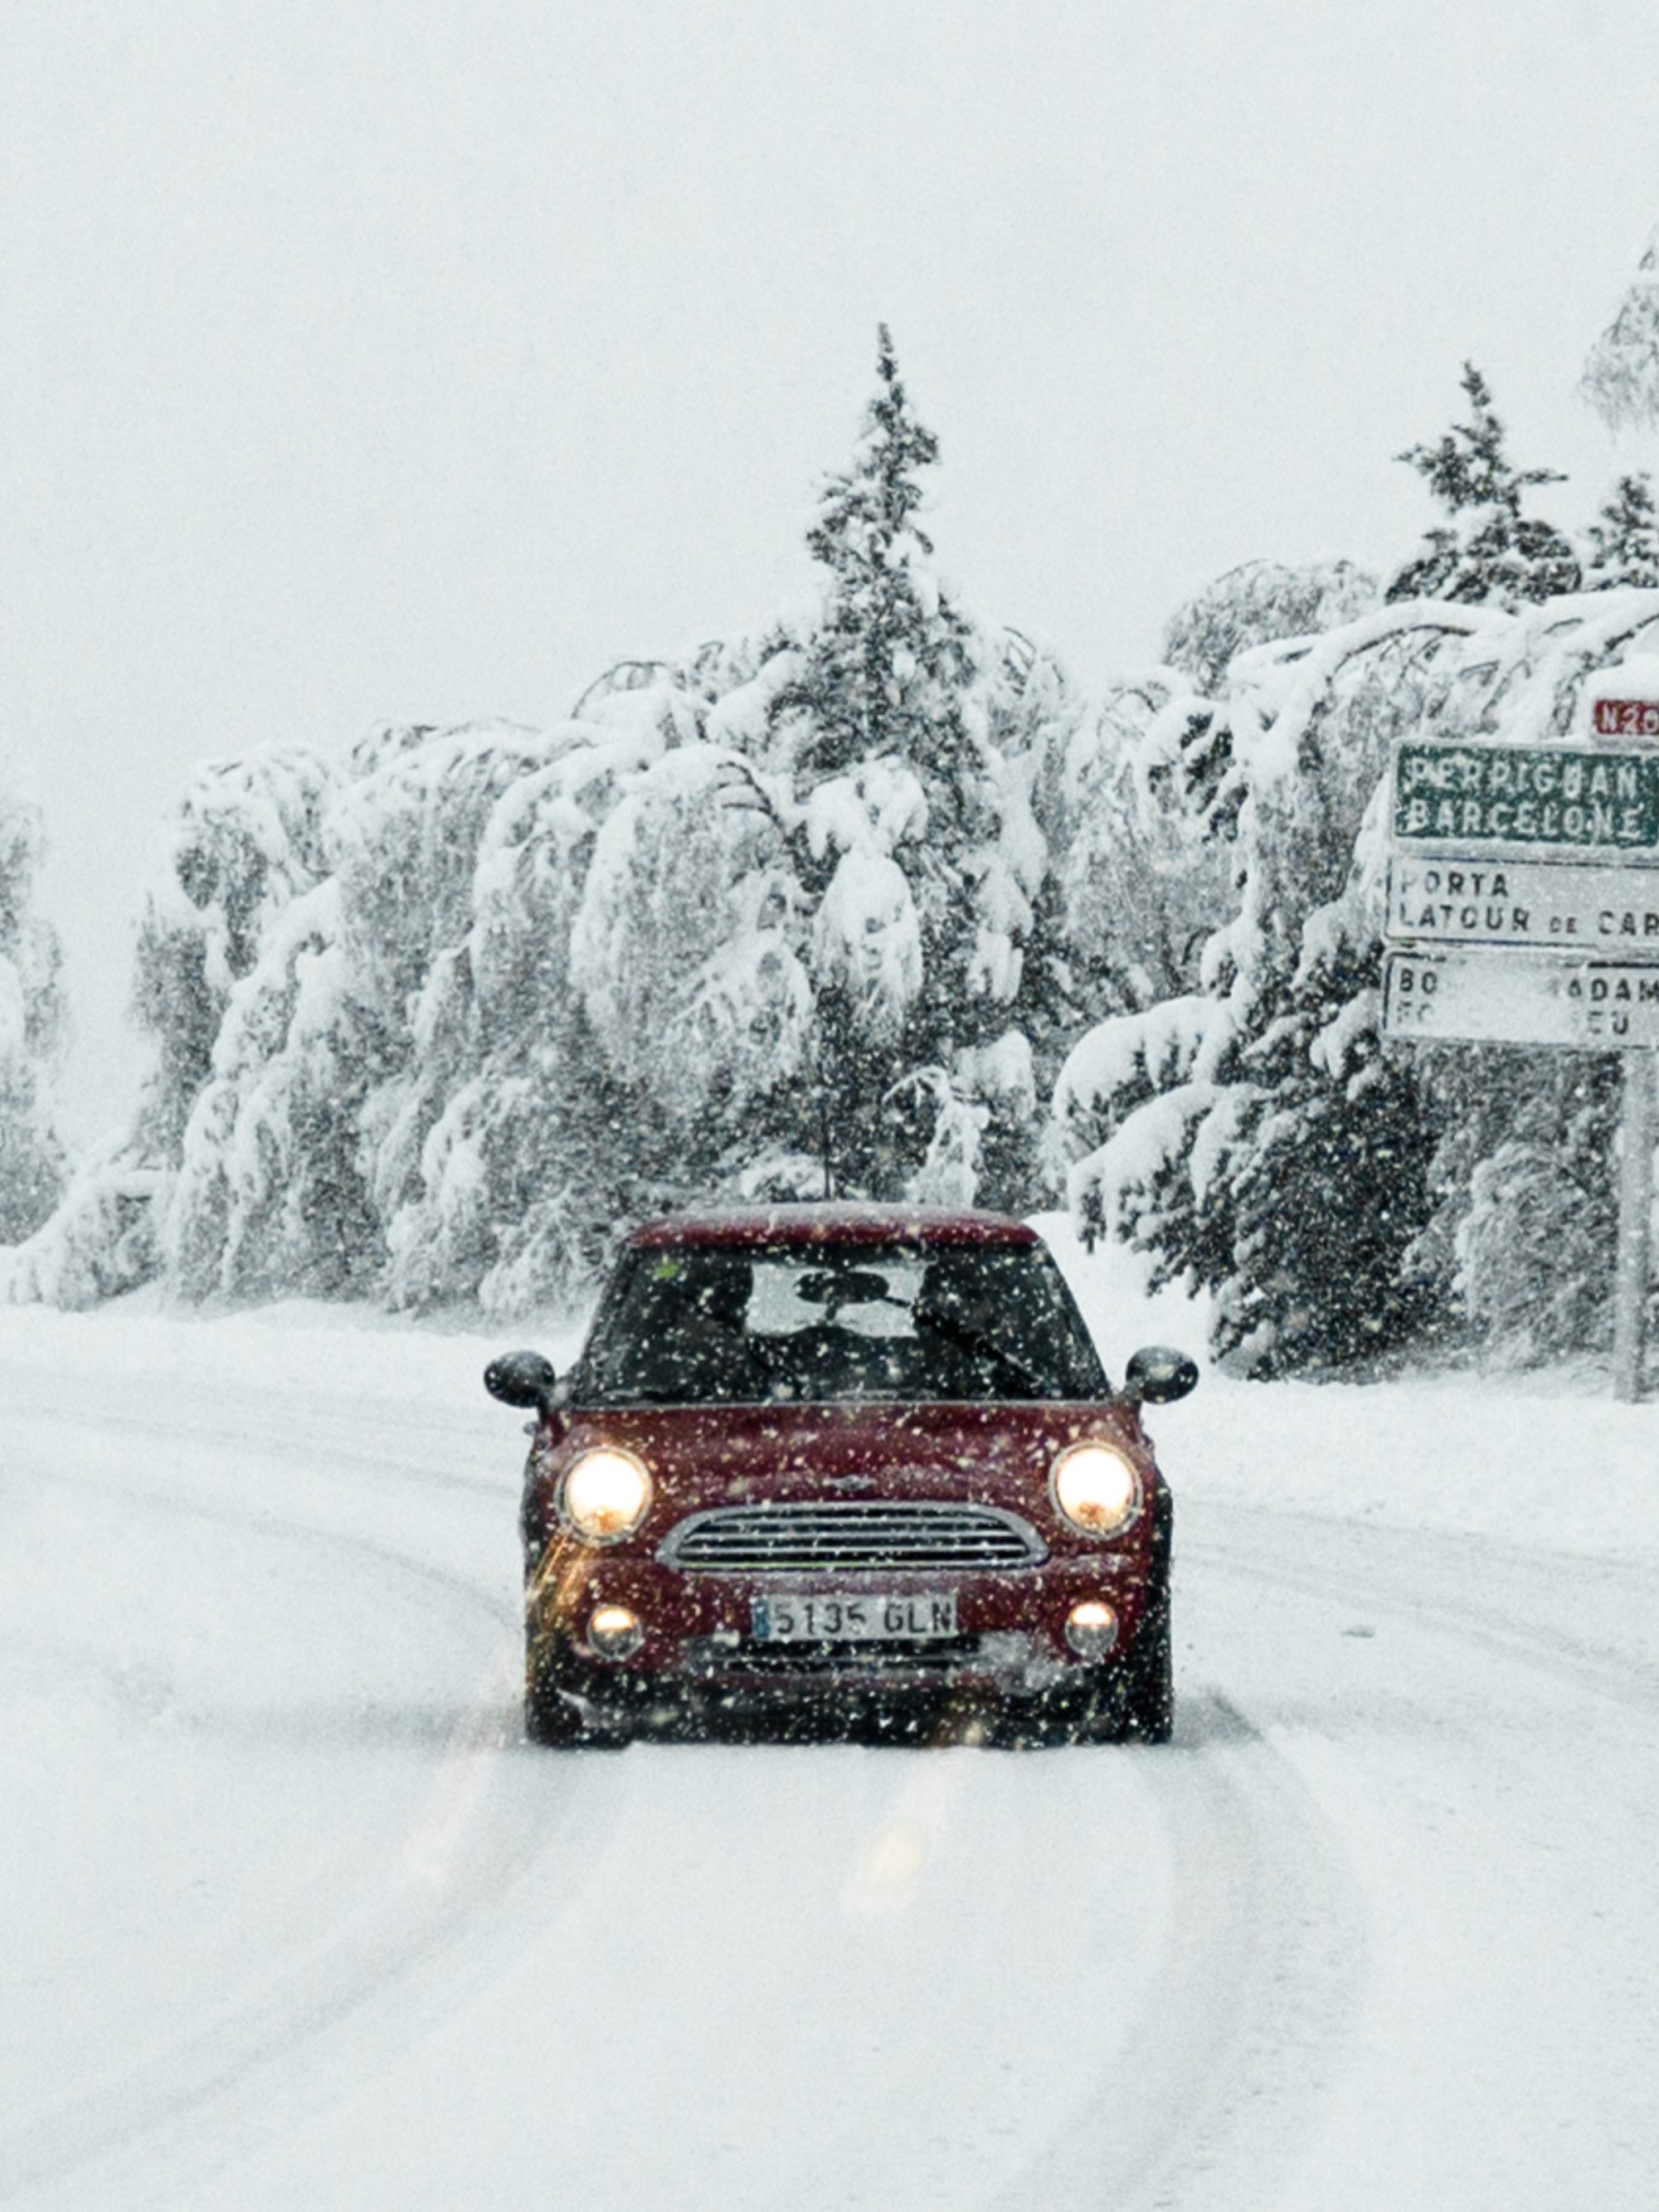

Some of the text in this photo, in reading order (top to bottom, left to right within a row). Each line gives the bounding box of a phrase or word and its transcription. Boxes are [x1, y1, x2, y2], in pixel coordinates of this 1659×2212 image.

[1602, 703, 1659, 733] N20
[1408, 799, 1642, 838] BARCELONE
[1399, 902, 1530, 931] LATOUR
[883, 1602, 952, 1635] GLN
